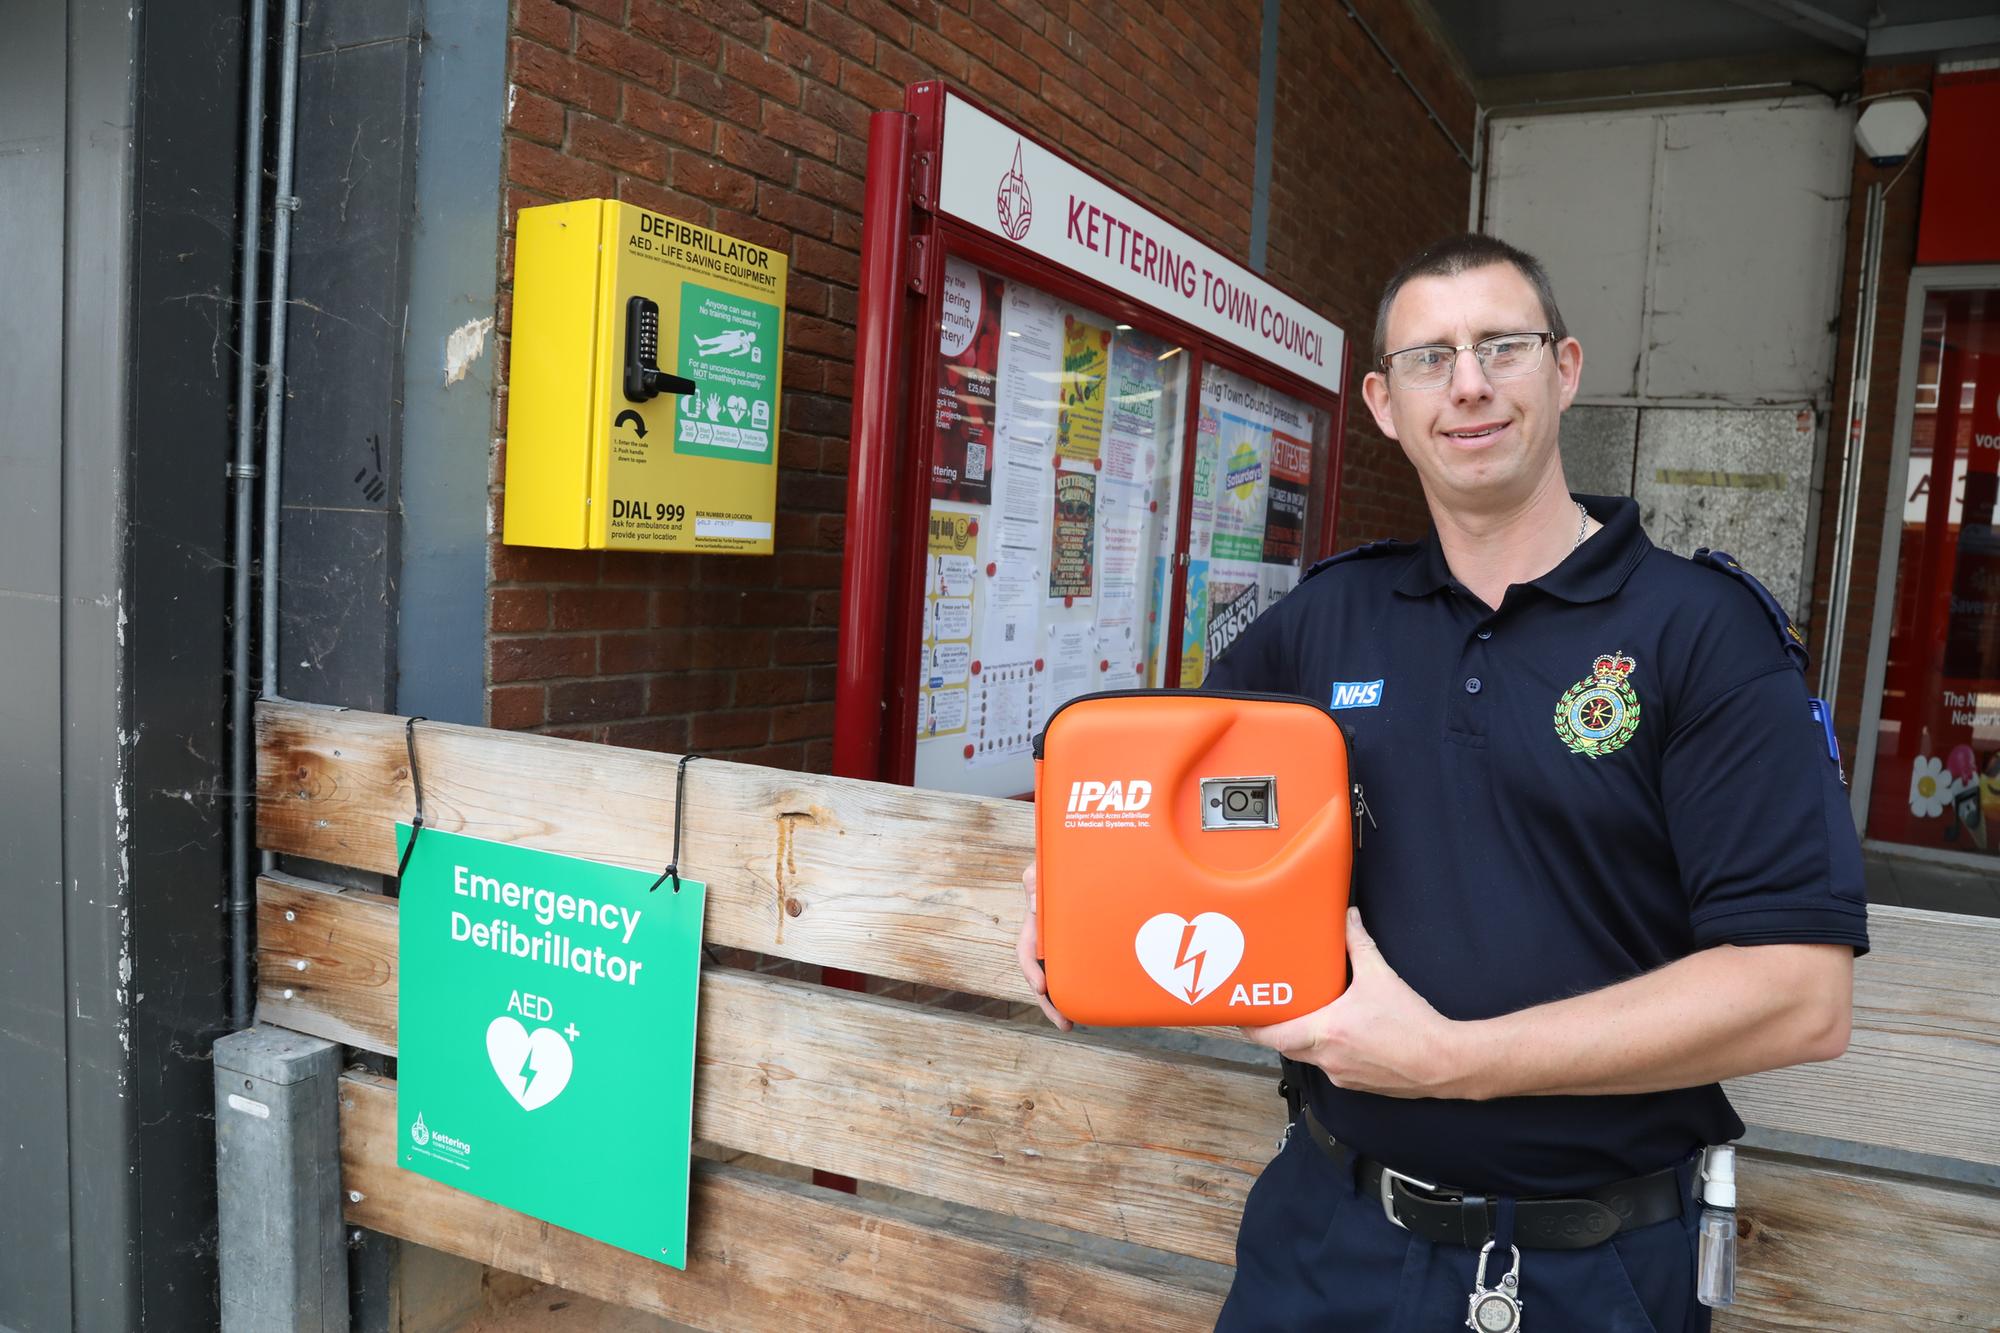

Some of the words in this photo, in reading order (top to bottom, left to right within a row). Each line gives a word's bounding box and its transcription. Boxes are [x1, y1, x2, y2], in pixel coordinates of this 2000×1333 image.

[641, 213, 768, 269] DEFIBRILLATOR
[630, 235, 652, 251] AED
[662, 244, 682, 260] LIFE
[686, 251, 721, 271] SAVING
[724, 263, 776, 287] EQUIPMENT
[955, 278, 966, 288] the
[1068, 194, 1195, 299] KETTERING
[1203, 269, 1257, 332] TOWN
[1261, 305, 1323, 366] COUNCIL
[705, 299, 728, 312] Anyone
[729, 306, 740, 314] can
[741, 309, 751, 317] use
[944, 290, 970, 313] tering
[699, 306, 708, 315] No
[709, 309, 731, 322] training
[732, 316, 761, 329] necessary
[689, 358, 699, 366] For
[709, 364, 745, 377] unconscious
[747, 372, 766, 381] person
[694, 369, 707, 378] NOT
[708, 371, 736, 385] breathing
[737, 378, 761, 390] normally
[968, 383, 990, 396] £25,000
[1223, 384, 1243, 406] Town
[1244, 393, 1273, 416] Council
[948, 399, 958, 409] into
[1057, 475, 1094, 493] KETTERING
[1227, 468, 1261, 487] Saturdays
[1060, 488, 1090, 504] CARNIVAL
[613, 500, 651, 520] DIAL
[656, 504, 685, 521] 999
[612, 520, 624, 528] Ask
[636, 522, 669, 530] ambulance
[612, 531, 636, 539] provide
[653, 533, 677, 541] location
[1209, 604, 1234, 635] FRIDAY
[1235, 586, 1255, 611] NIGHT
[1210, 600, 1256, 660] DISCO
[1333, 684, 1380, 706] NHS
[1944, 691, 1965, 707] The
[1067, 780, 1152, 812] IPAD
[1105, 821, 1136, 829] Systems,
[454, 865, 642, 944] Emergency
[451, 912, 642, 985] Defibrillator
[1229, 983, 1293, 1006] AED
[507, 990, 553, 1022] AED
[432, 1130, 470, 1154] Kettering
[432, 1141, 445, 1149] TOWN
[446, 1146, 464, 1156] COUNCIL
